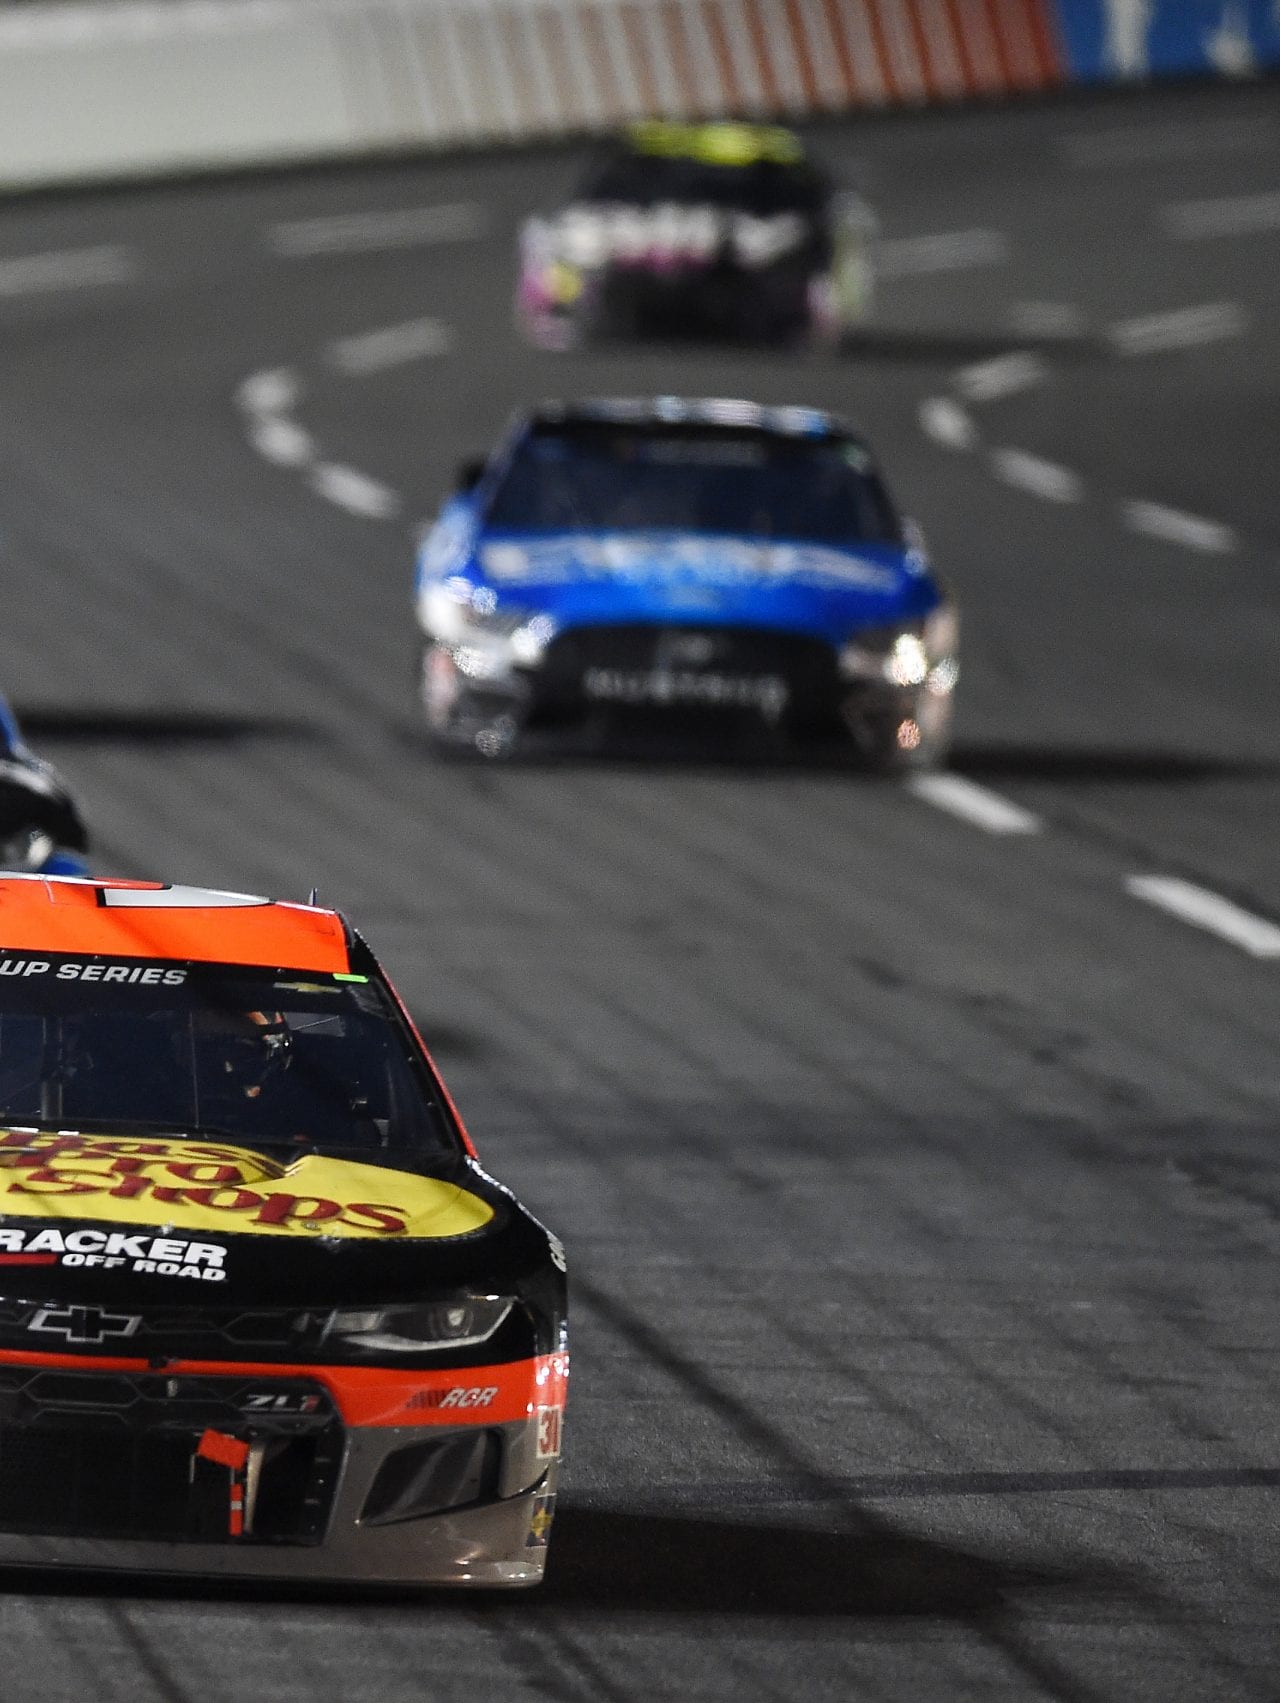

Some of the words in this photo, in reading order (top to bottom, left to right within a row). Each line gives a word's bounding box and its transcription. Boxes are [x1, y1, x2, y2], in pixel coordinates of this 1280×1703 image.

[56, 963, 188, 985] SERIES
[6, 1168, 410, 1234] Shops
[61, 1253, 126, 1269] OFF
[132, 1259, 227, 1282] ROAD
